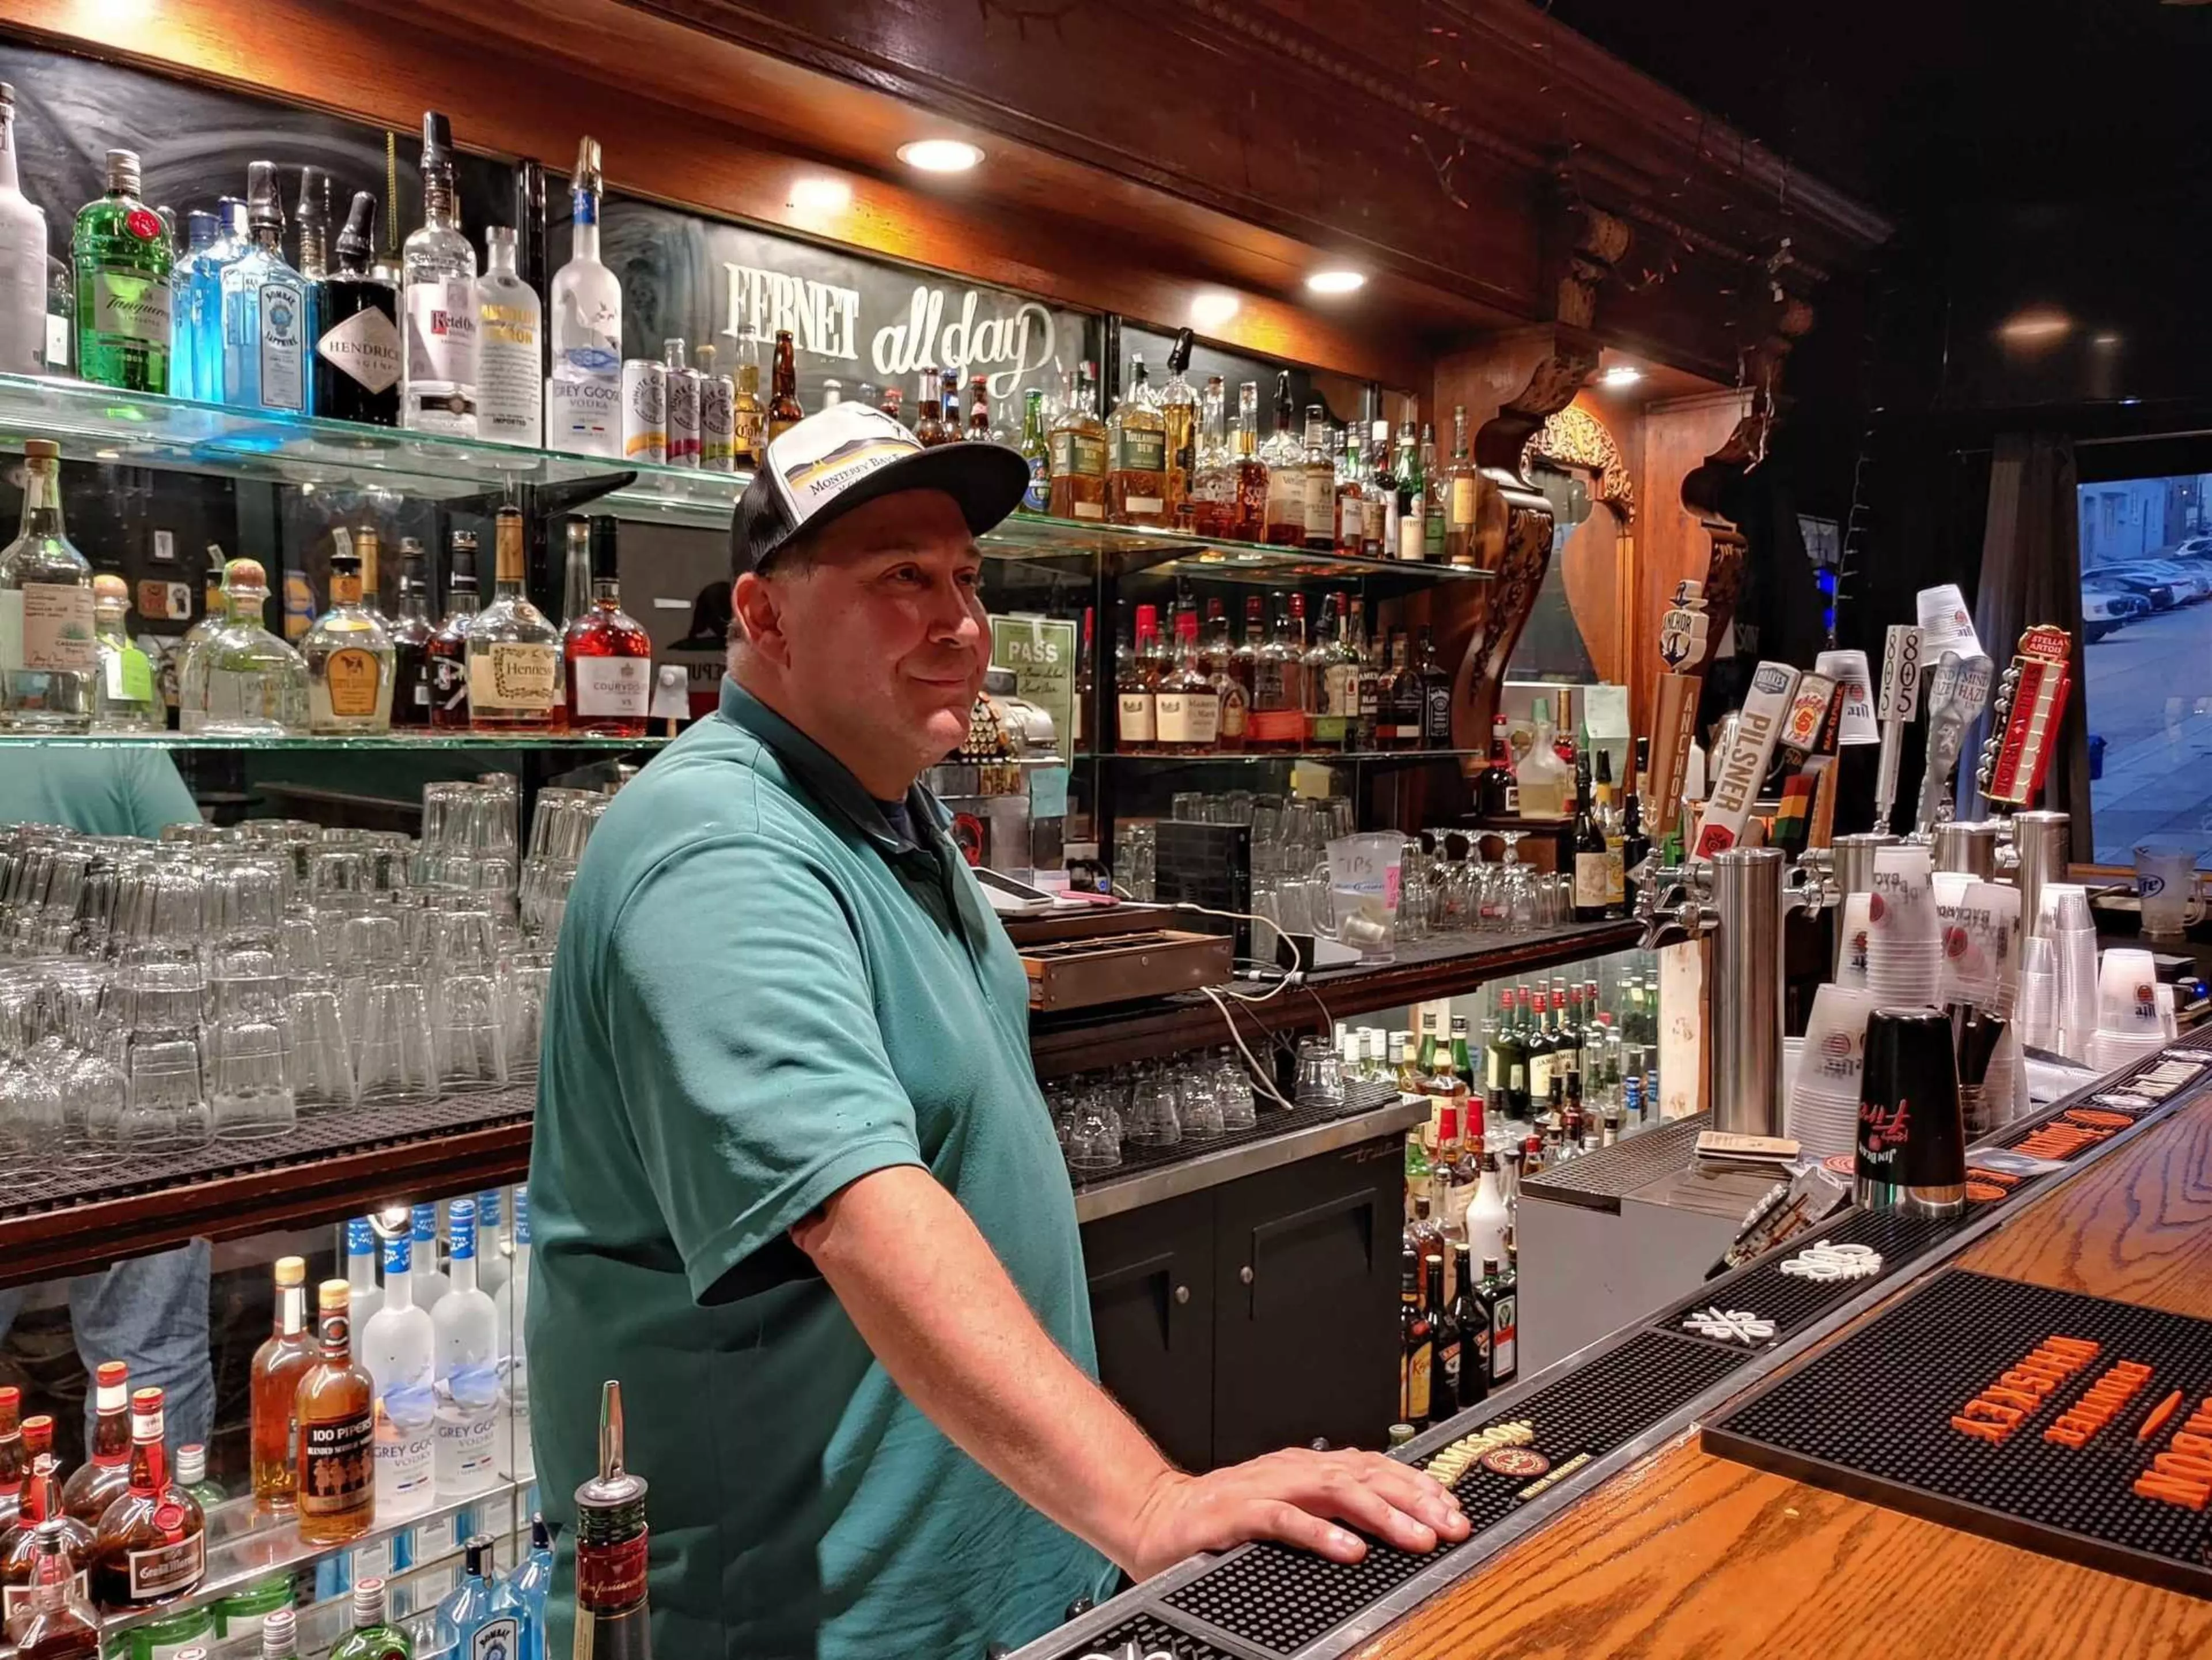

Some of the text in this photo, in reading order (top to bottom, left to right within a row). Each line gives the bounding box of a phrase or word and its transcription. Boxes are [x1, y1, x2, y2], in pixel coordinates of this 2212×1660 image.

[266, 290, 297, 306] BOMBAY
[721, 262, 1056, 399] FERNET all day
[808, 463, 868, 496] MONTEREY
[1662, 611, 1692, 634] ANCHOR
[1008, 640, 1058, 663] PASS
[2031, 635, 2063, 646] STELLA
[1880, 634, 1897, 713] 805
[1897, 634, 1918, 713] 805
[1795, 710, 1814, 732] 5
[1666, 692, 1695, 818] ANCHOR
[1714, 712, 1772, 812] PILSNER
[1338, 856, 1373, 874] TIPS
[1950, 1334, 2100, 1447] WHISKEY
[313, 1419, 373, 1443] 100 PIPERS
[440, 1425, 470, 1439] GREY
[307, 1446, 334, 1455] BLENDED
[373, 1444, 406, 1458] GREY
[1423, 1420, 1534, 1489] JAMESON
